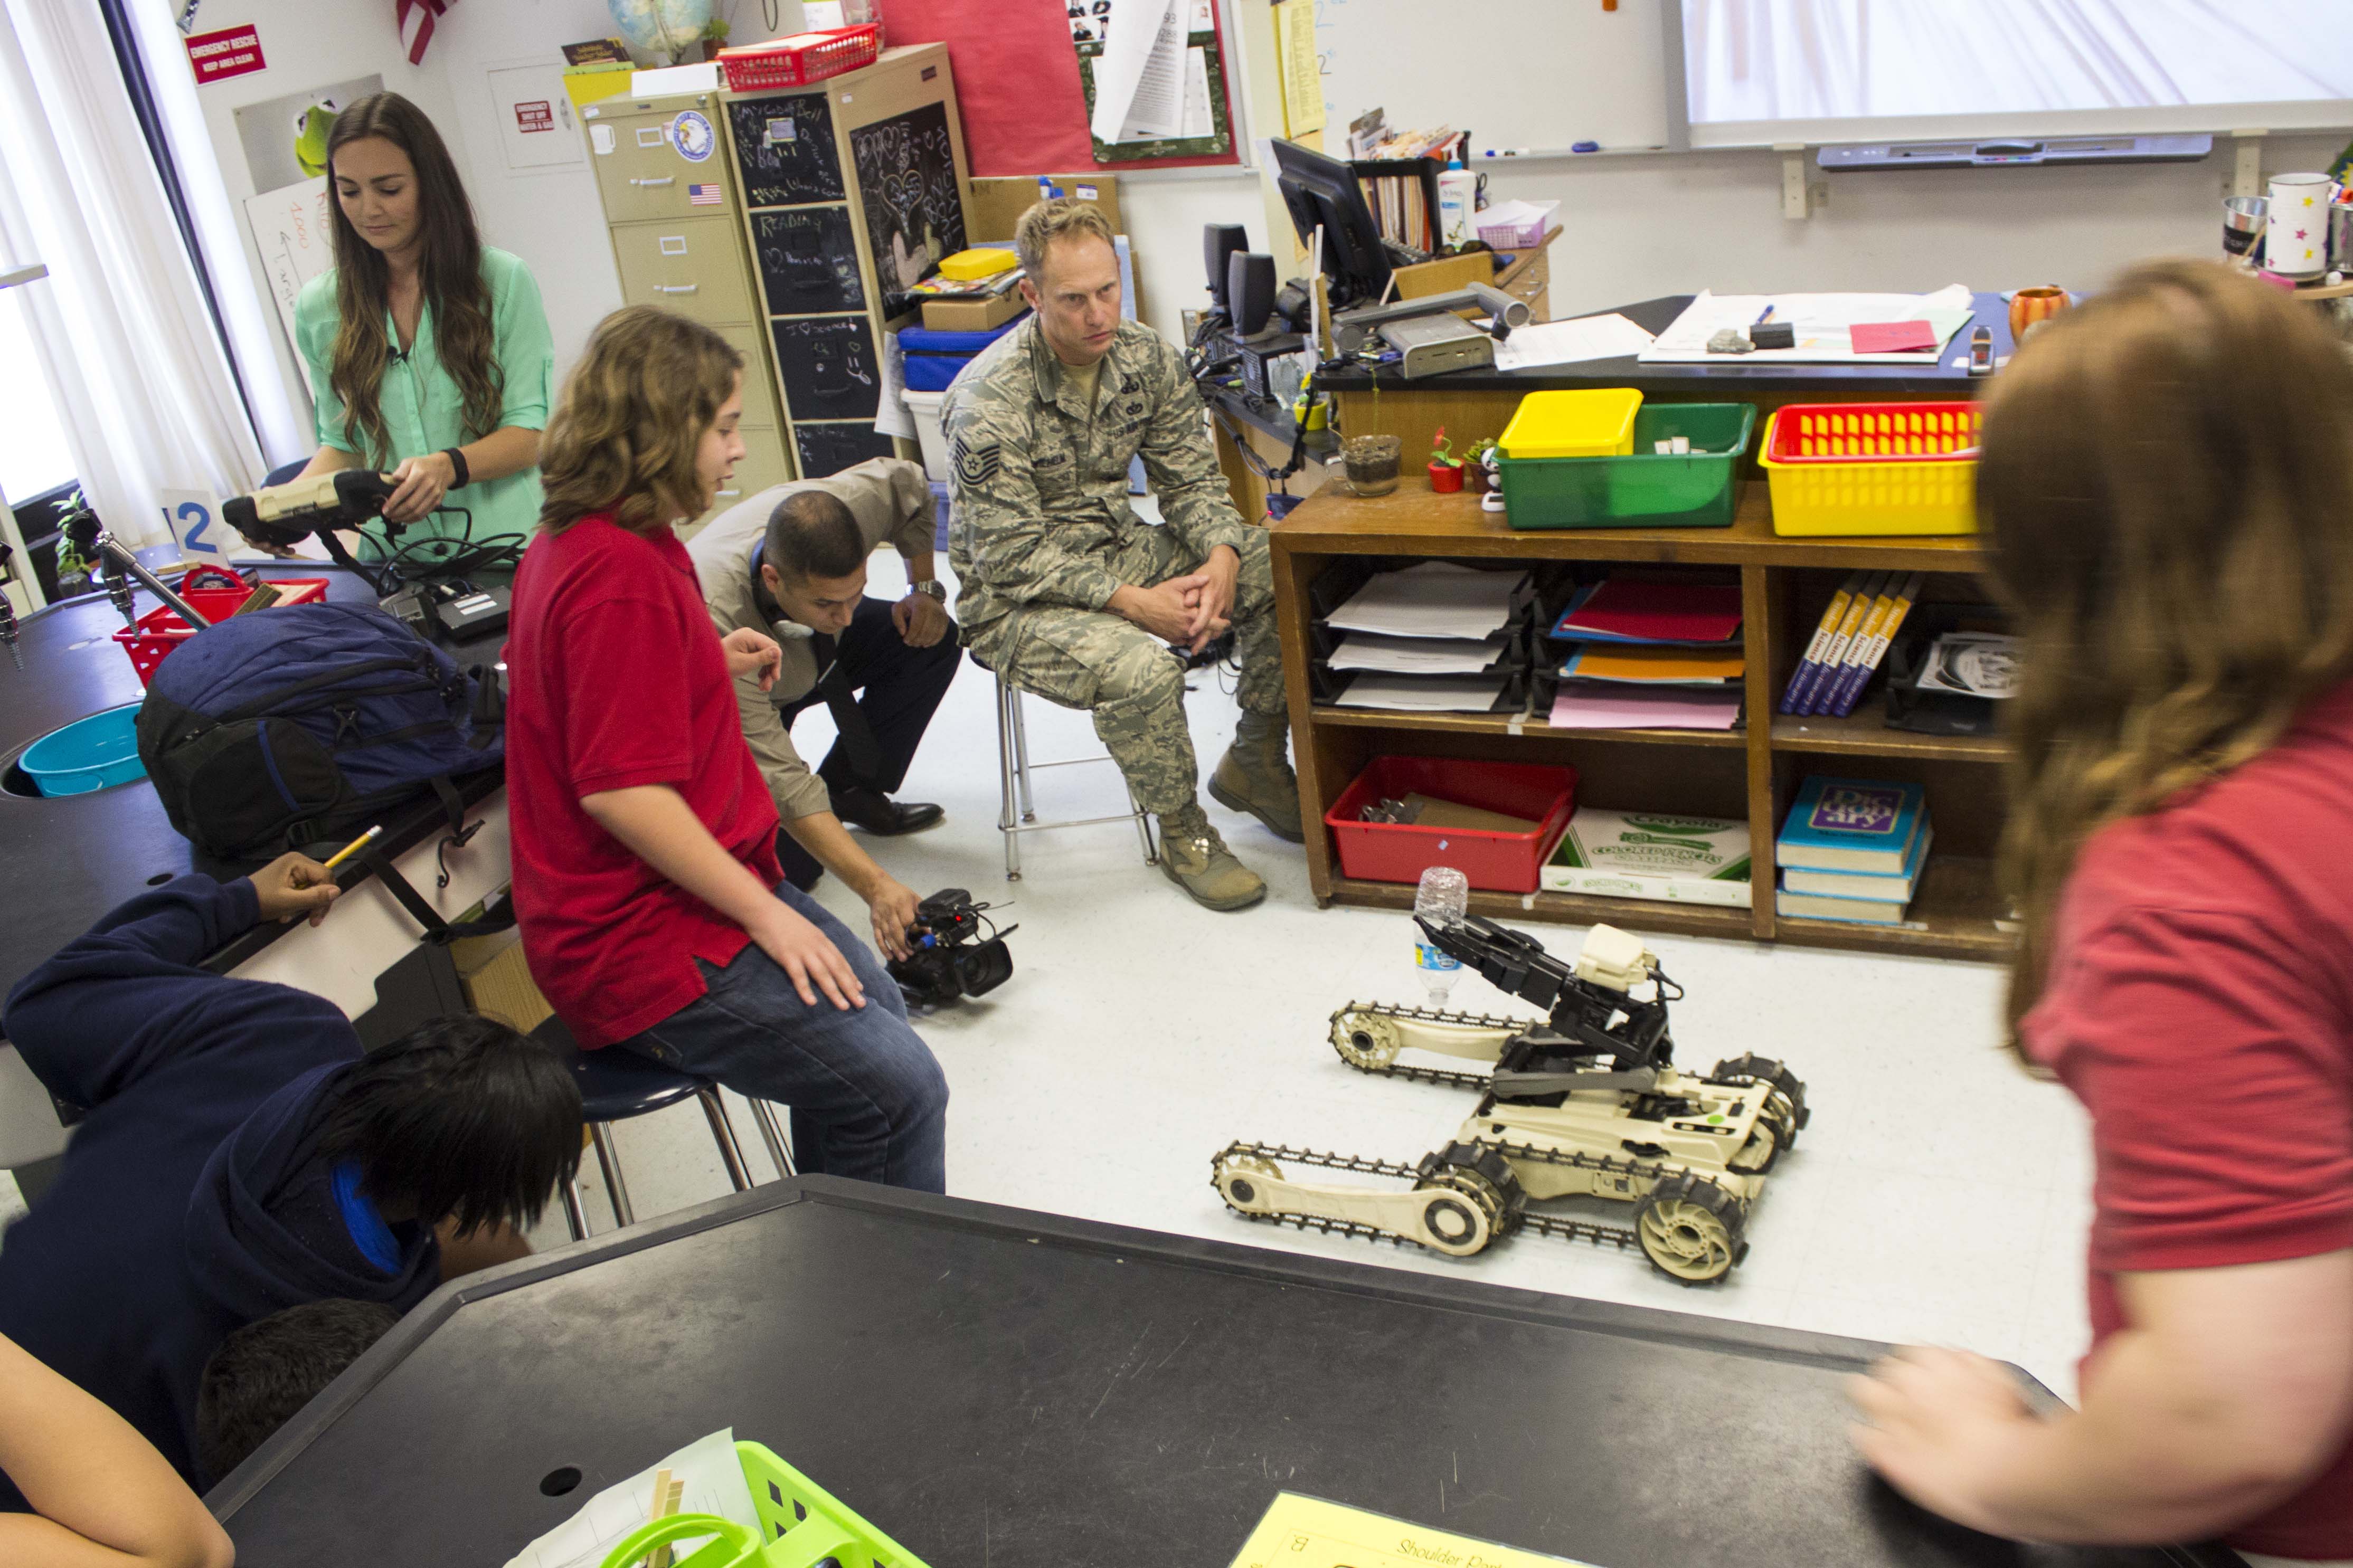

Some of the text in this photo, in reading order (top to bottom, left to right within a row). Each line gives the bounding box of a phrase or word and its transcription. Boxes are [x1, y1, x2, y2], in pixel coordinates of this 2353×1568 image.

[190, 34, 258, 59] EMERGENCY RESCUE
[219, 57, 235, 69] AREA
[234, 53, 254, 64] CLEAR
[177, 502, 218, 554] 2
[1807, 631, 1829, 662] Science
[1825, 634, 1847, 664] Science
[1845, 634, 1868, 665] Science
[1863, 635, 1887, 668] Science
[1396, 1538, 1463, 1566] Shoulder
